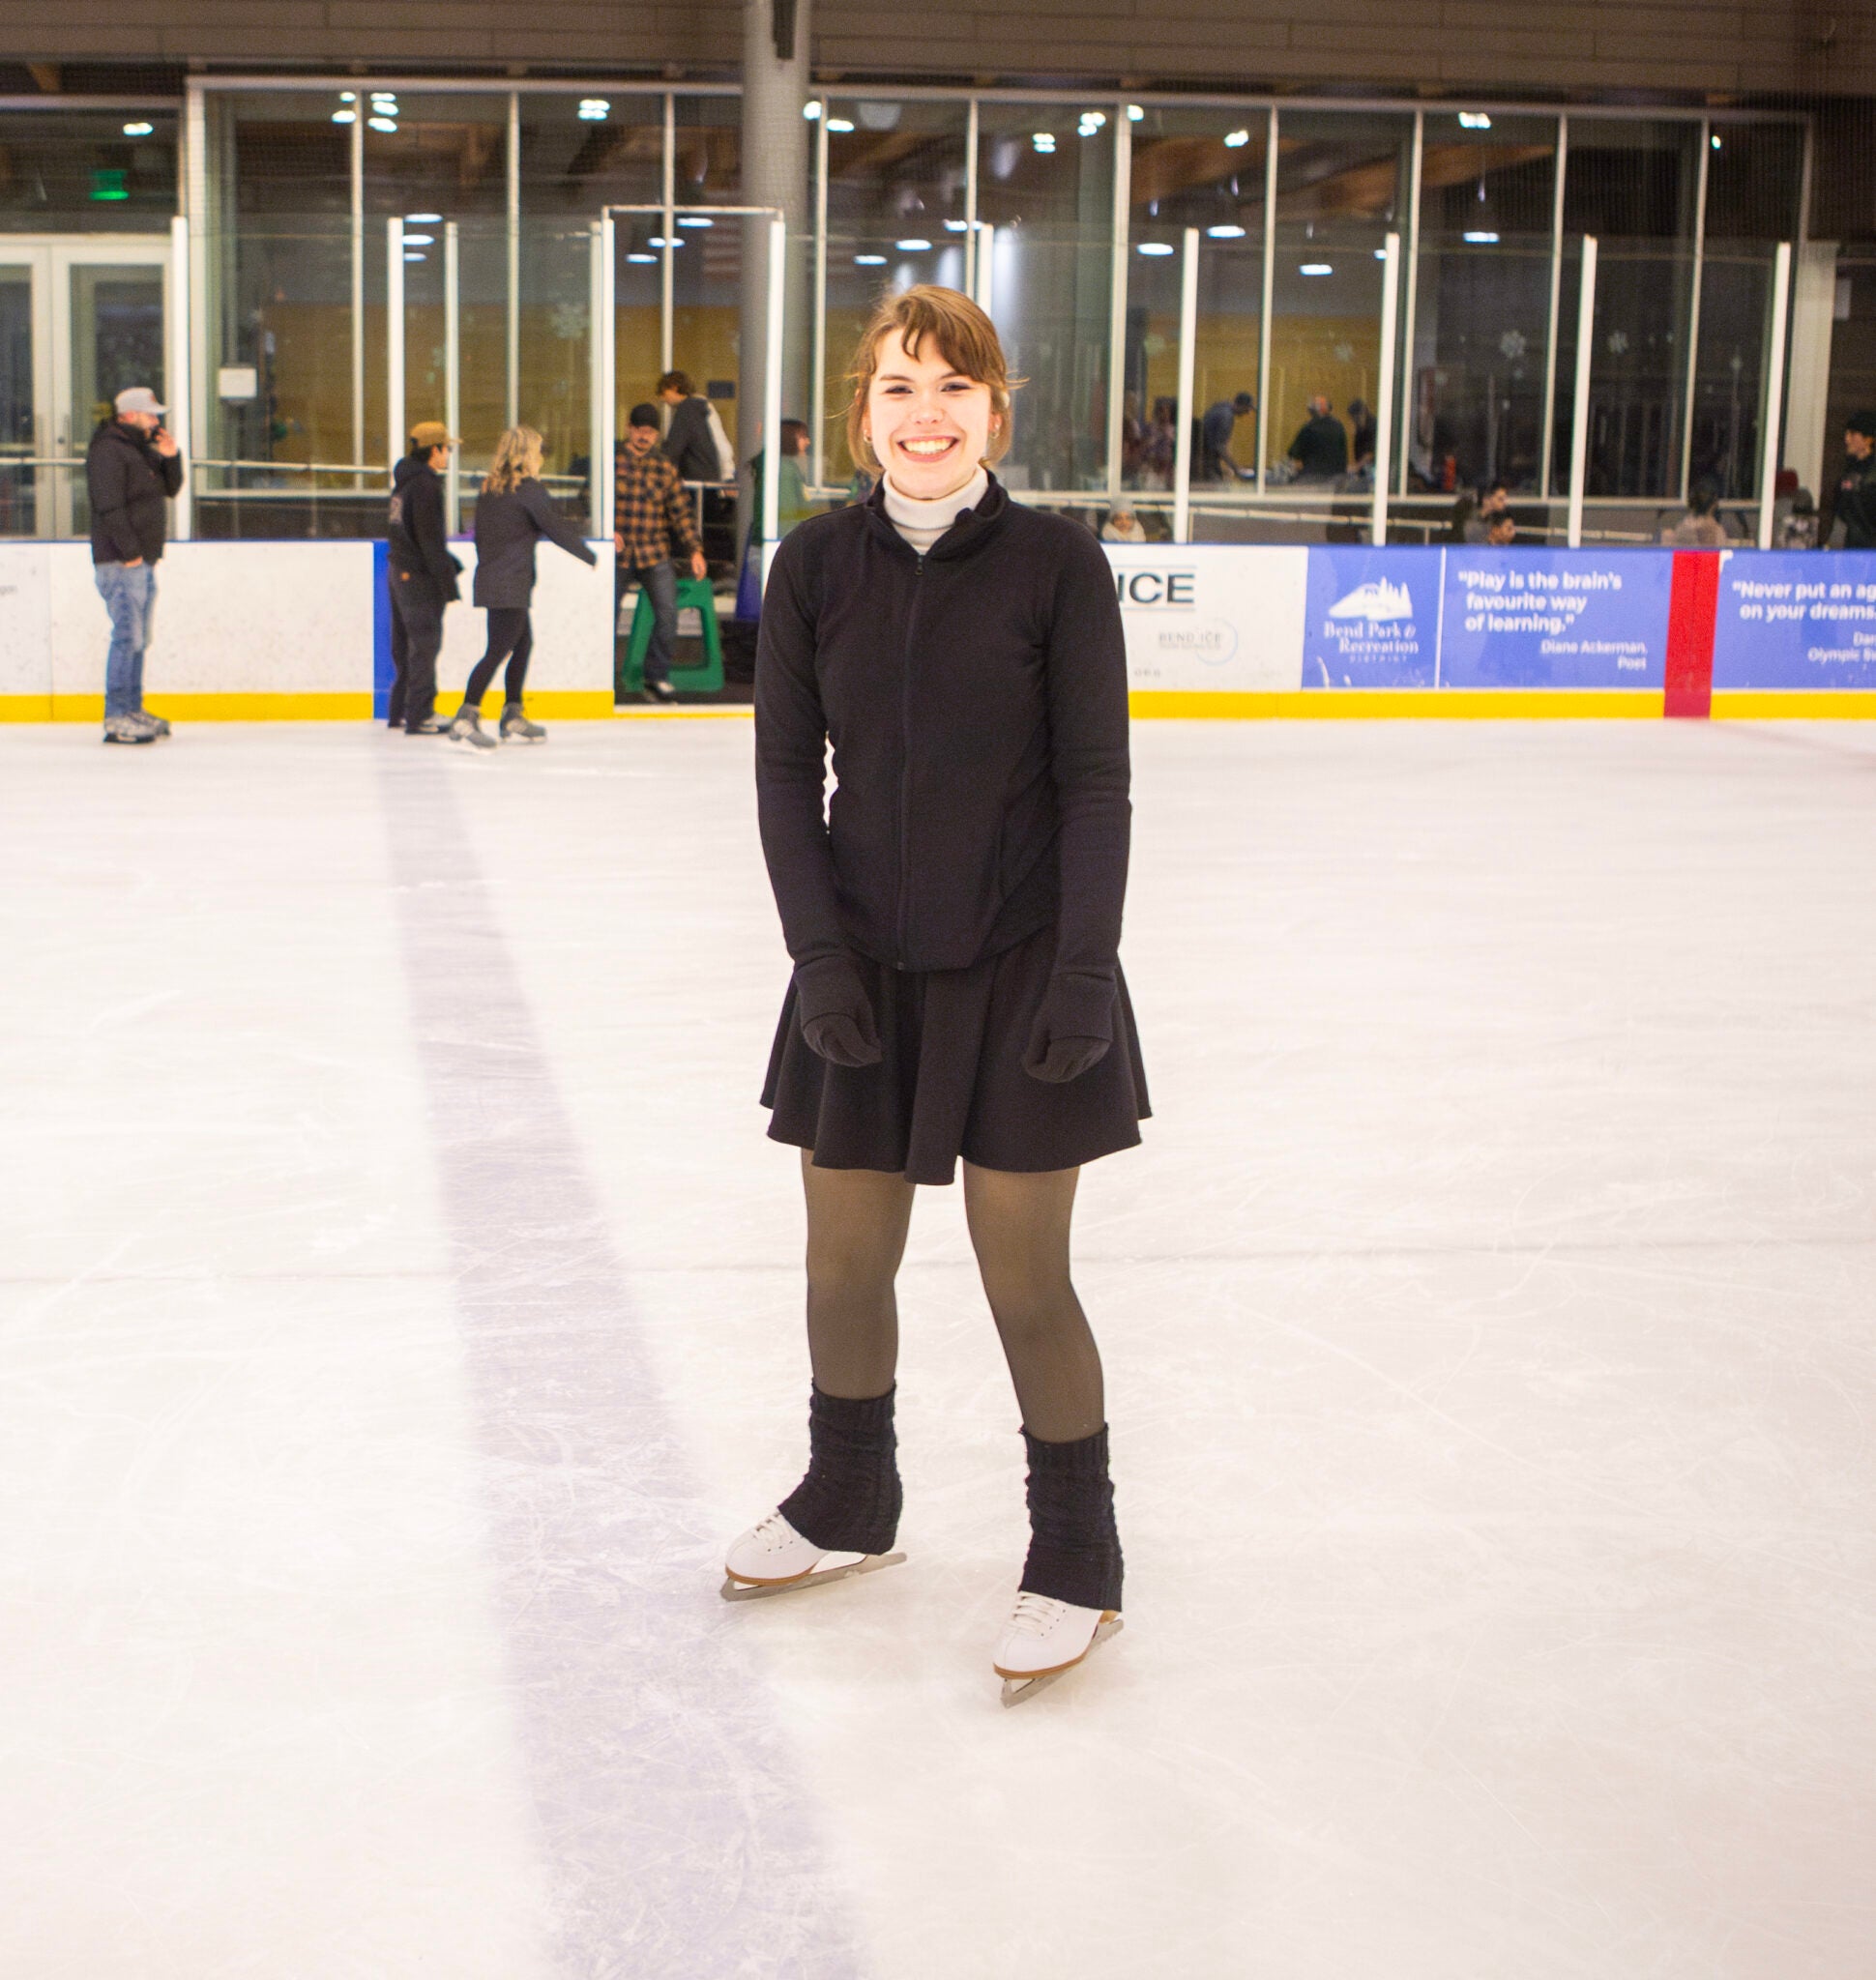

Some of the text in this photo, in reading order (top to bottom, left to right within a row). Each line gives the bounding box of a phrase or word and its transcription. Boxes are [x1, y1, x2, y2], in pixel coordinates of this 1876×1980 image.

[1118, 572, 1195, 604] ICE
[1458, 570, 1623, 592] "Play is the brain's
[1732, 580, 1792, 599] "Never
[1795, 582, 1826, 601] put
[1830, 583, 1852, 598] an
[1466, 592, 1587, 614] favourite way
[1740, 605, 1762, 620] on
[1766, 604, 1806, 623] your
[1324, 621, 1363, 638] Bend
[1368, 621, 1401, 638] Park
[1465, 613, 1575, 635] of learning."
[1338, 637, 1420, 655] Recreation
[1540, 639, 1578, 655] Diane
[1807, 647, 1861, 665] Olympic
